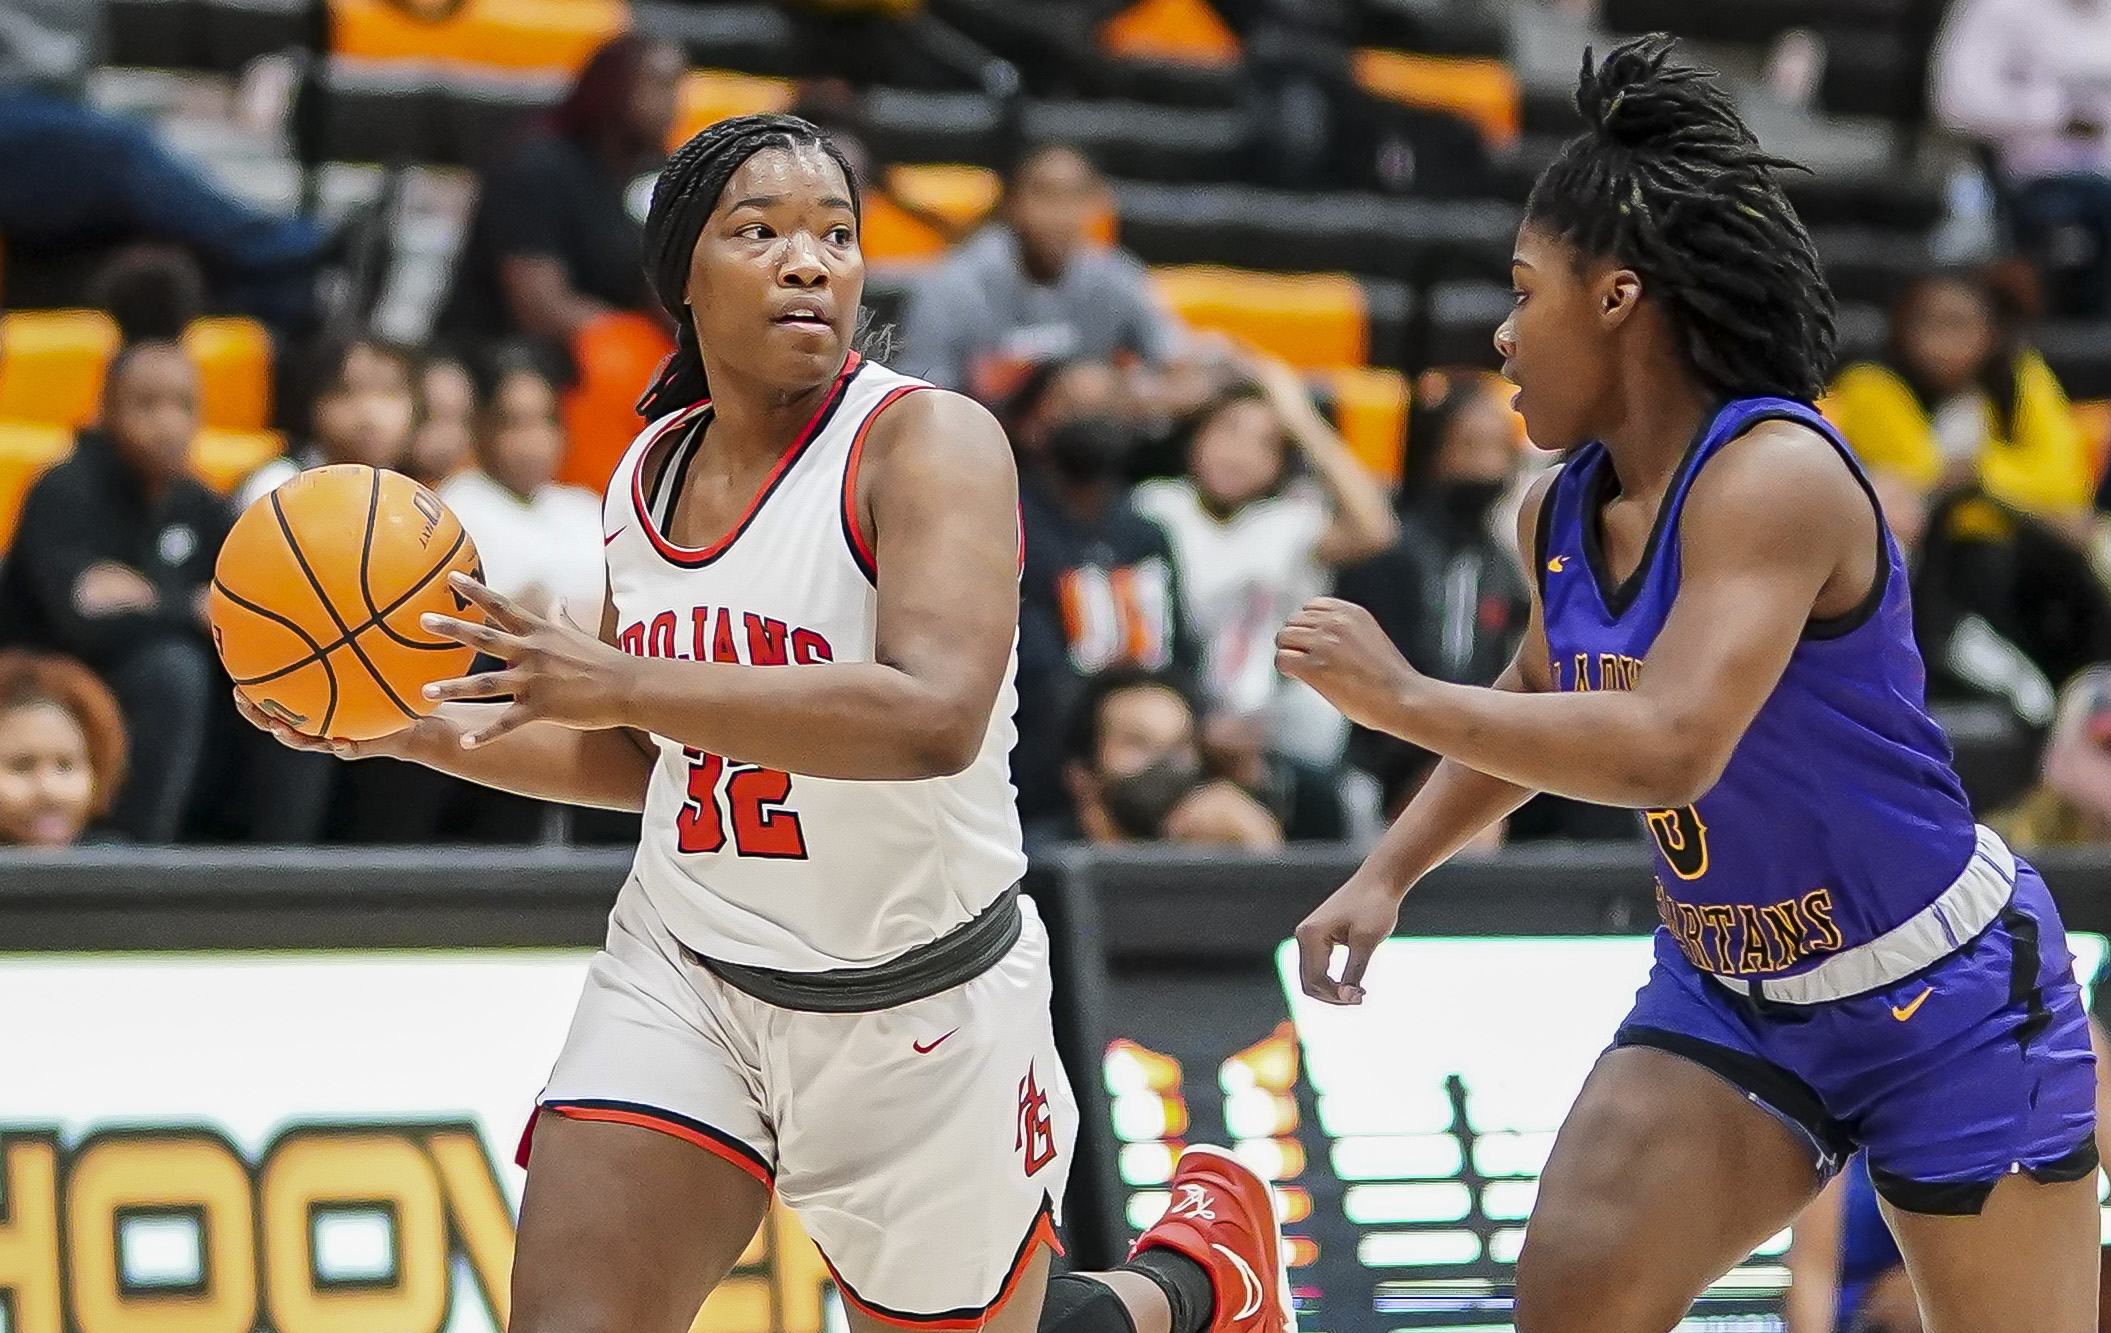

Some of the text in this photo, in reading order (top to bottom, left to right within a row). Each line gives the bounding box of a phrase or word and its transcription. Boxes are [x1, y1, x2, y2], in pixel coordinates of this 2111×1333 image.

[619, 606, 834, 666] ROJANS
[676, 744, 809, 860] 32
[1654, 875, 1842, 974] ARTANS
